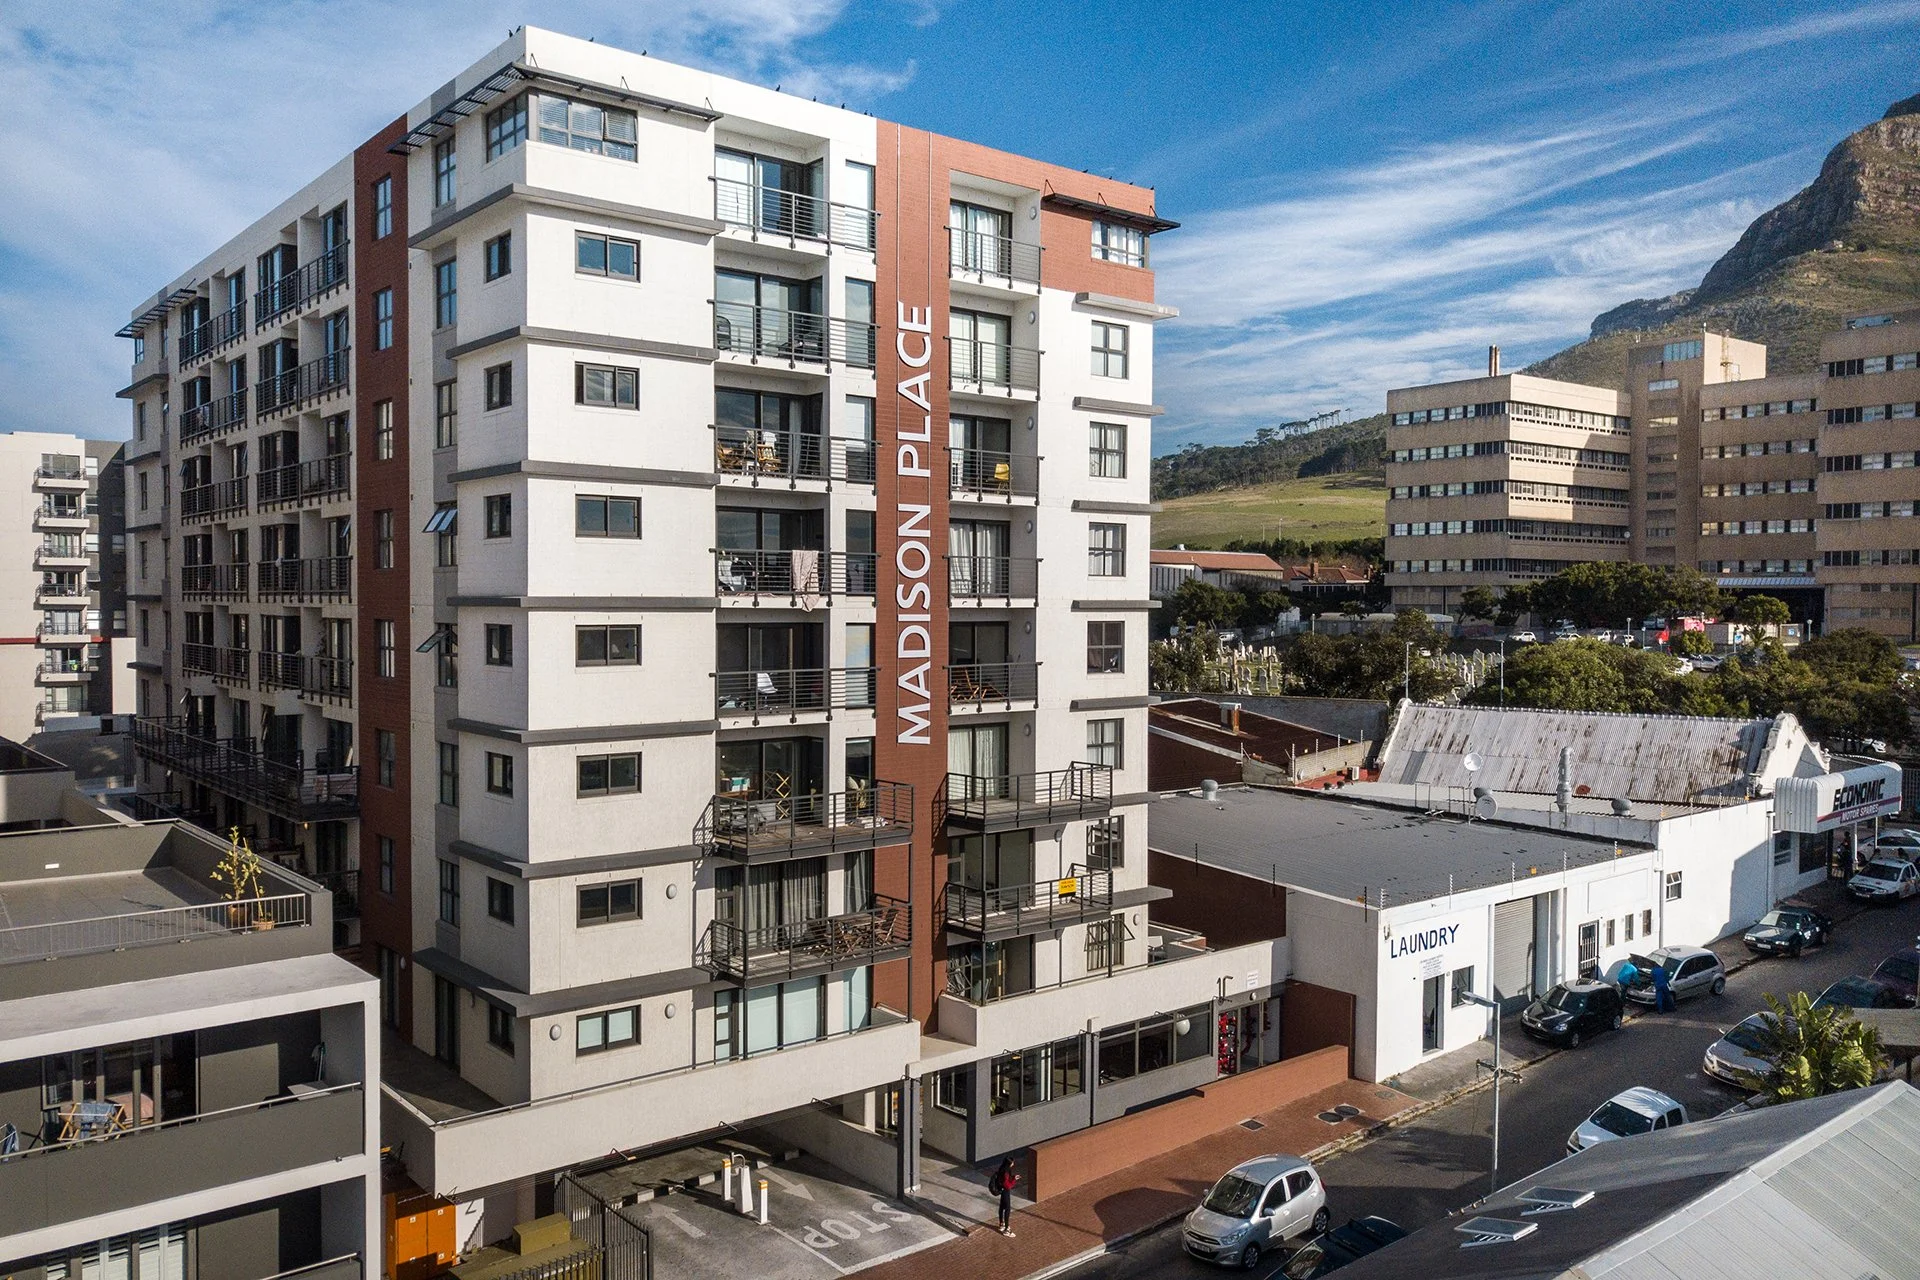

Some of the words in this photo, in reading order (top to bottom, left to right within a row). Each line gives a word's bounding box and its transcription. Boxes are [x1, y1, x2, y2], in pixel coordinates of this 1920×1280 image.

[896, 300, 931, 478] PLACE
[896, 503, 931, 745] MADISON
[1833, 778, 1885, 811] ECONOMIC
[1841, 808, 1859, 821] MOTOR
[1859, 803, 1879, 817] SPARES
[1391, 924, 1460, 959] LAUNDRY
[803, 1201, 912, 1249] STOP
